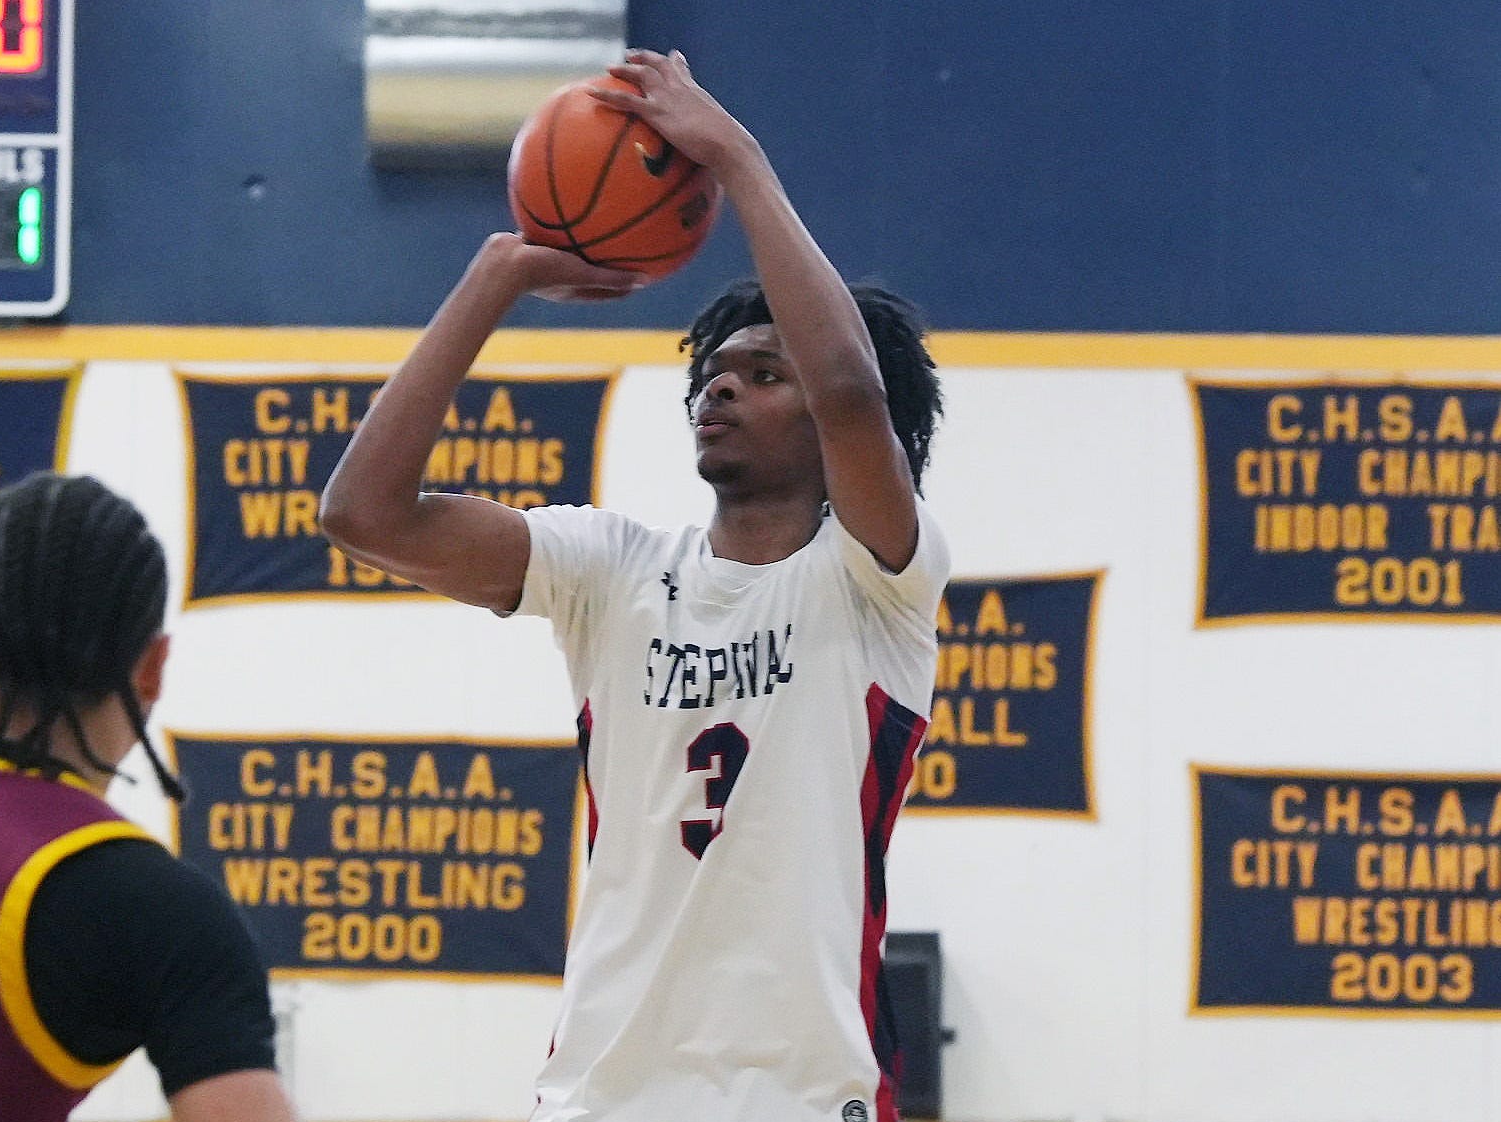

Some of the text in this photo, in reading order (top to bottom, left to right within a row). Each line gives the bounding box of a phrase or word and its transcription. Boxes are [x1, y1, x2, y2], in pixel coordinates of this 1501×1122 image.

[18, 187, 42, 264] 1
[224, 438, 310, 488] CITY
[1236, 448, 1321, 496] CITY
[1254, 503, 1388, 552] INDOOR
[1335, 557, 1464, 606] 2001
[240, 749, 513, 800] C.H.S.A.A.
[680, 722, 750, 861] 3
[208, 803, 544, 855] CITY CHAMPIONS
[224, 856, 526, 911] WRESTLING
[1231, 839, 1318, 889] CITY
[303, 913, 442, 963] 2000
[1331, 951, 1474, 1003] 2003
